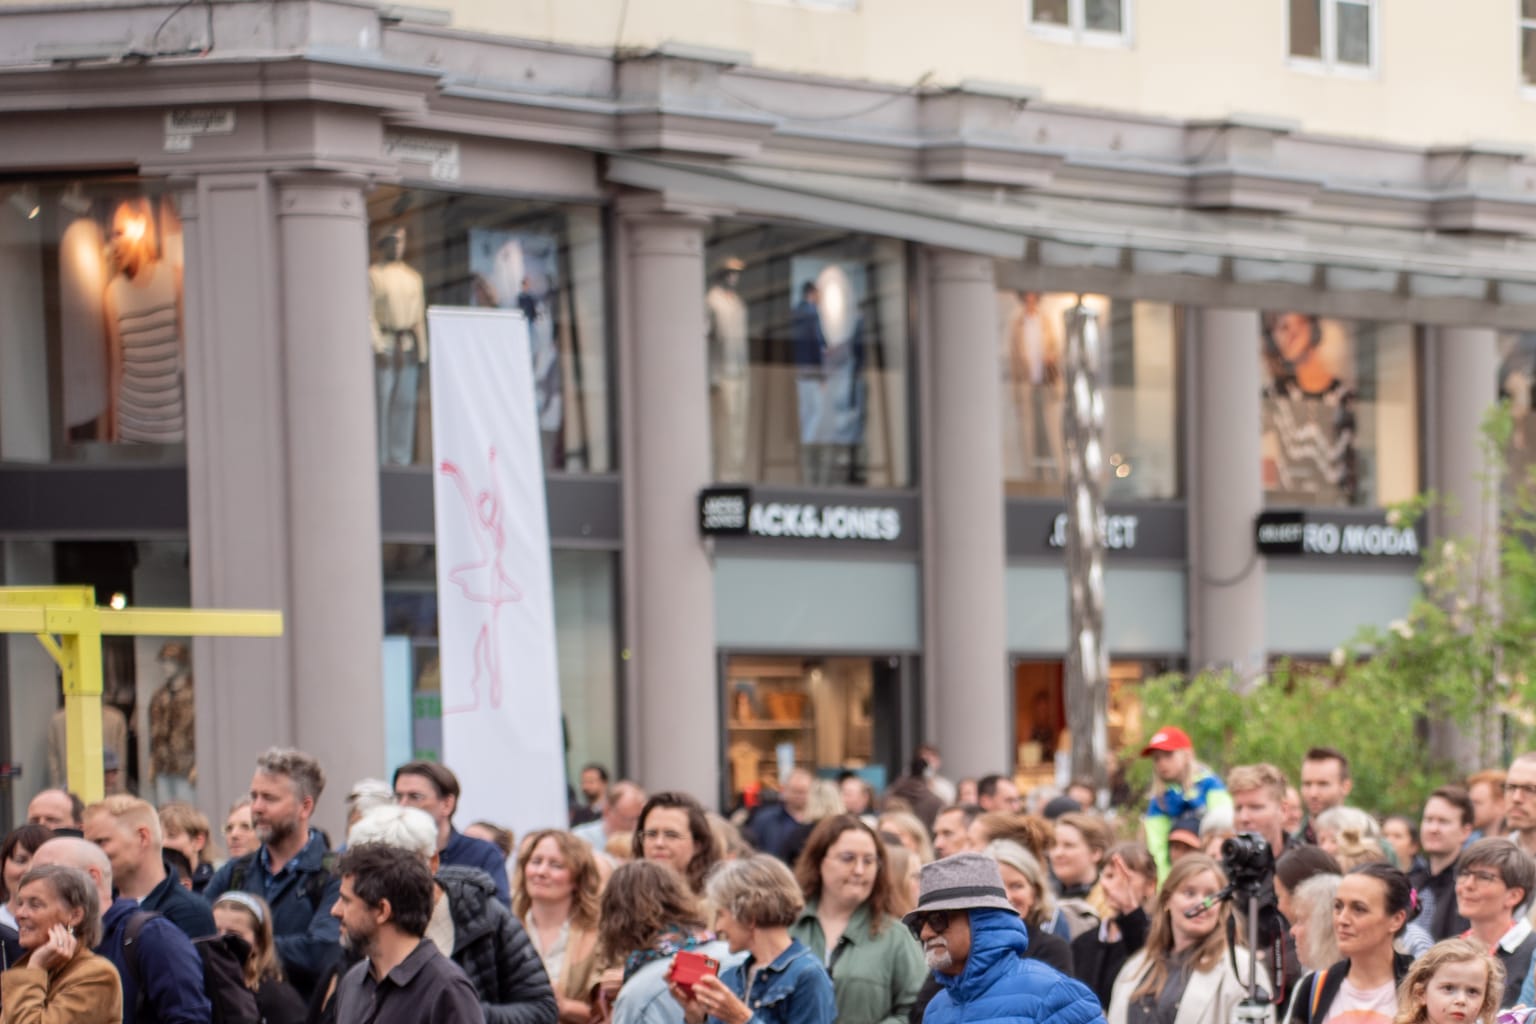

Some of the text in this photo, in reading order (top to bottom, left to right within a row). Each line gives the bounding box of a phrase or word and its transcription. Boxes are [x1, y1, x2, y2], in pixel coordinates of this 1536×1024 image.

[750, 503, 900, 540] ACK&JONES
[1302, 523, 1419, 556] RO MODA
